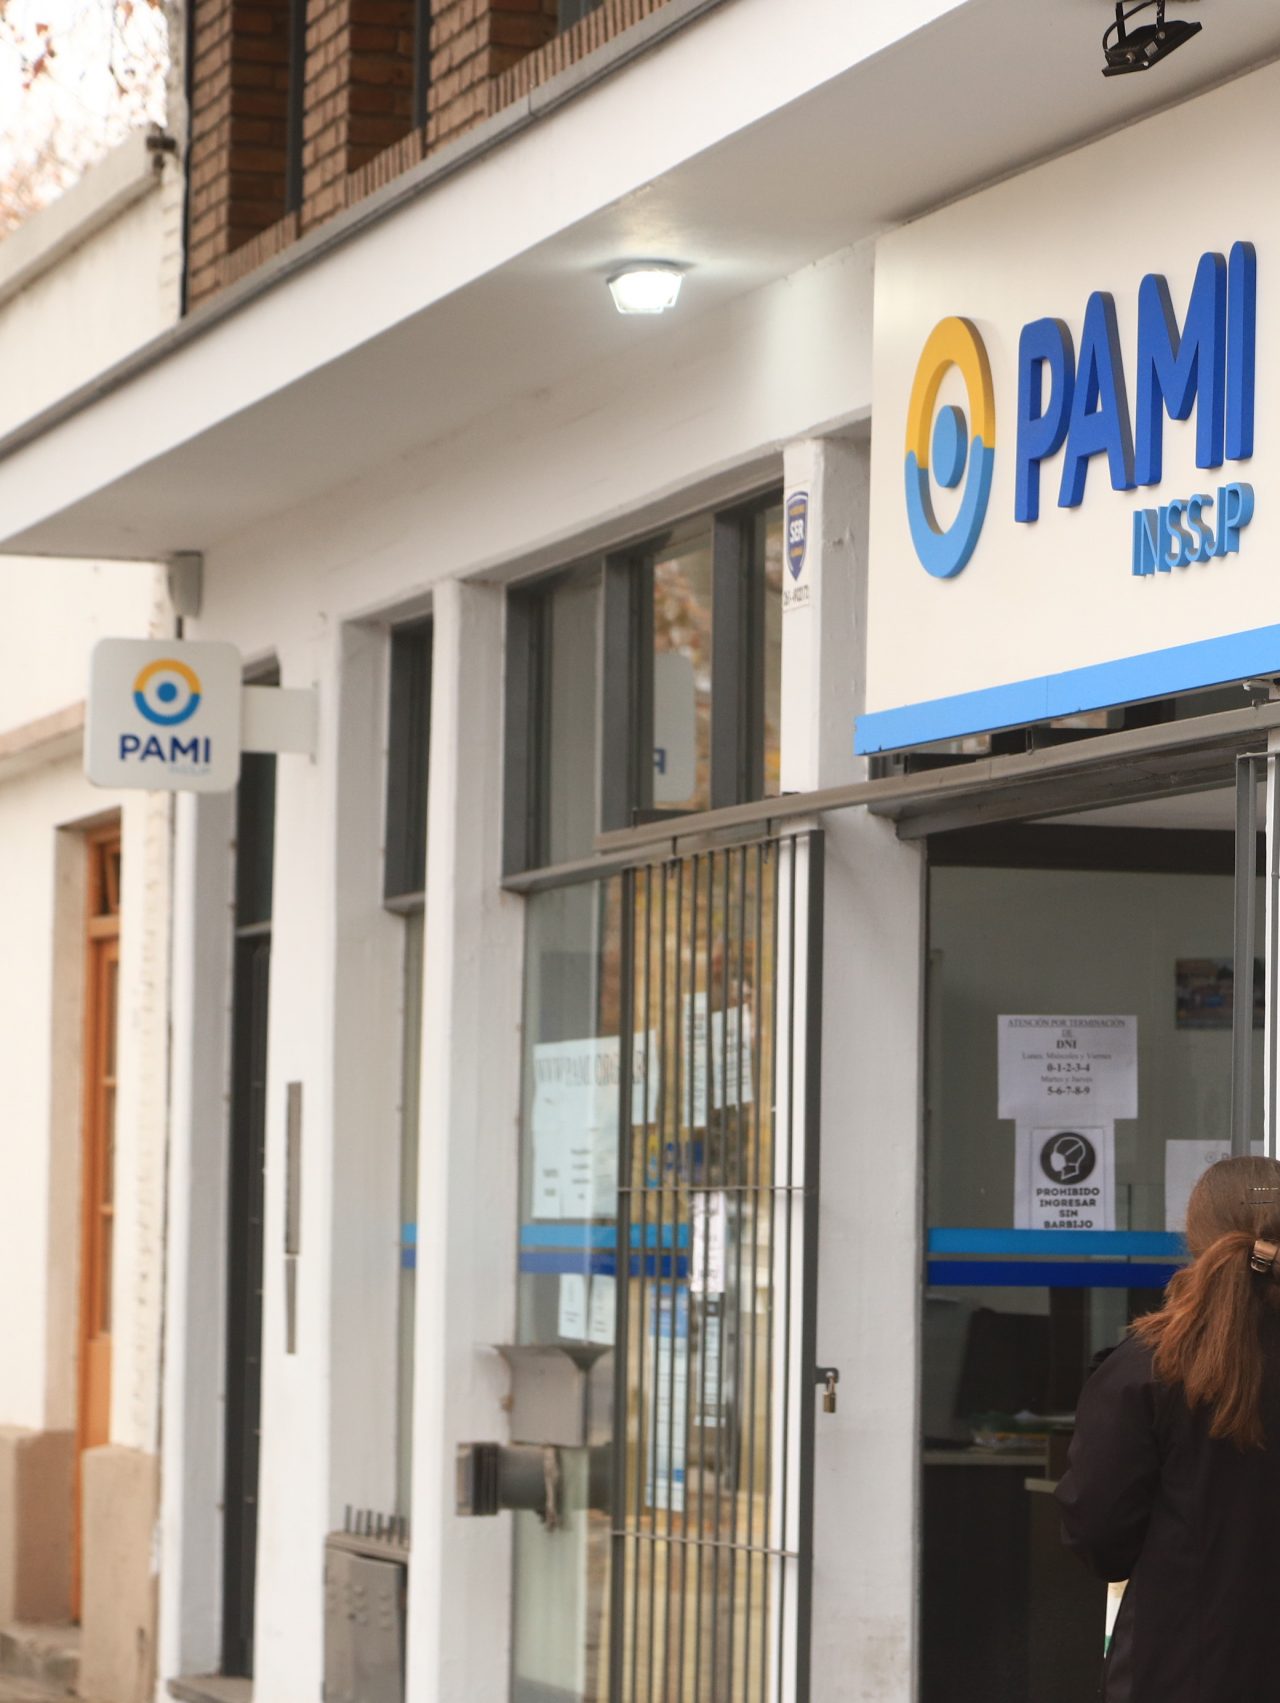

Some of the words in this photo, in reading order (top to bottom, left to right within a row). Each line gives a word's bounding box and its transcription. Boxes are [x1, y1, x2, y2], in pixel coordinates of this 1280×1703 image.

[1015, 240, 1257, 524] PAMI
[1131, 482, 1255, 577] INSSJP
[118, 734, 211, 763] PAMI
[1056, 1039, 1077, 1049] DNI
[1047, 1085, 1090, 1096] 5-6-7-8-9
[1036, 1187, 1100, 1197] PROHIBIDO
[1040, 1198, 1097, 1208] INGRESAR
[1059, 1209, 1079, 1219] SIN
[1043, 1220, 1094, 1229] BARBIJO
